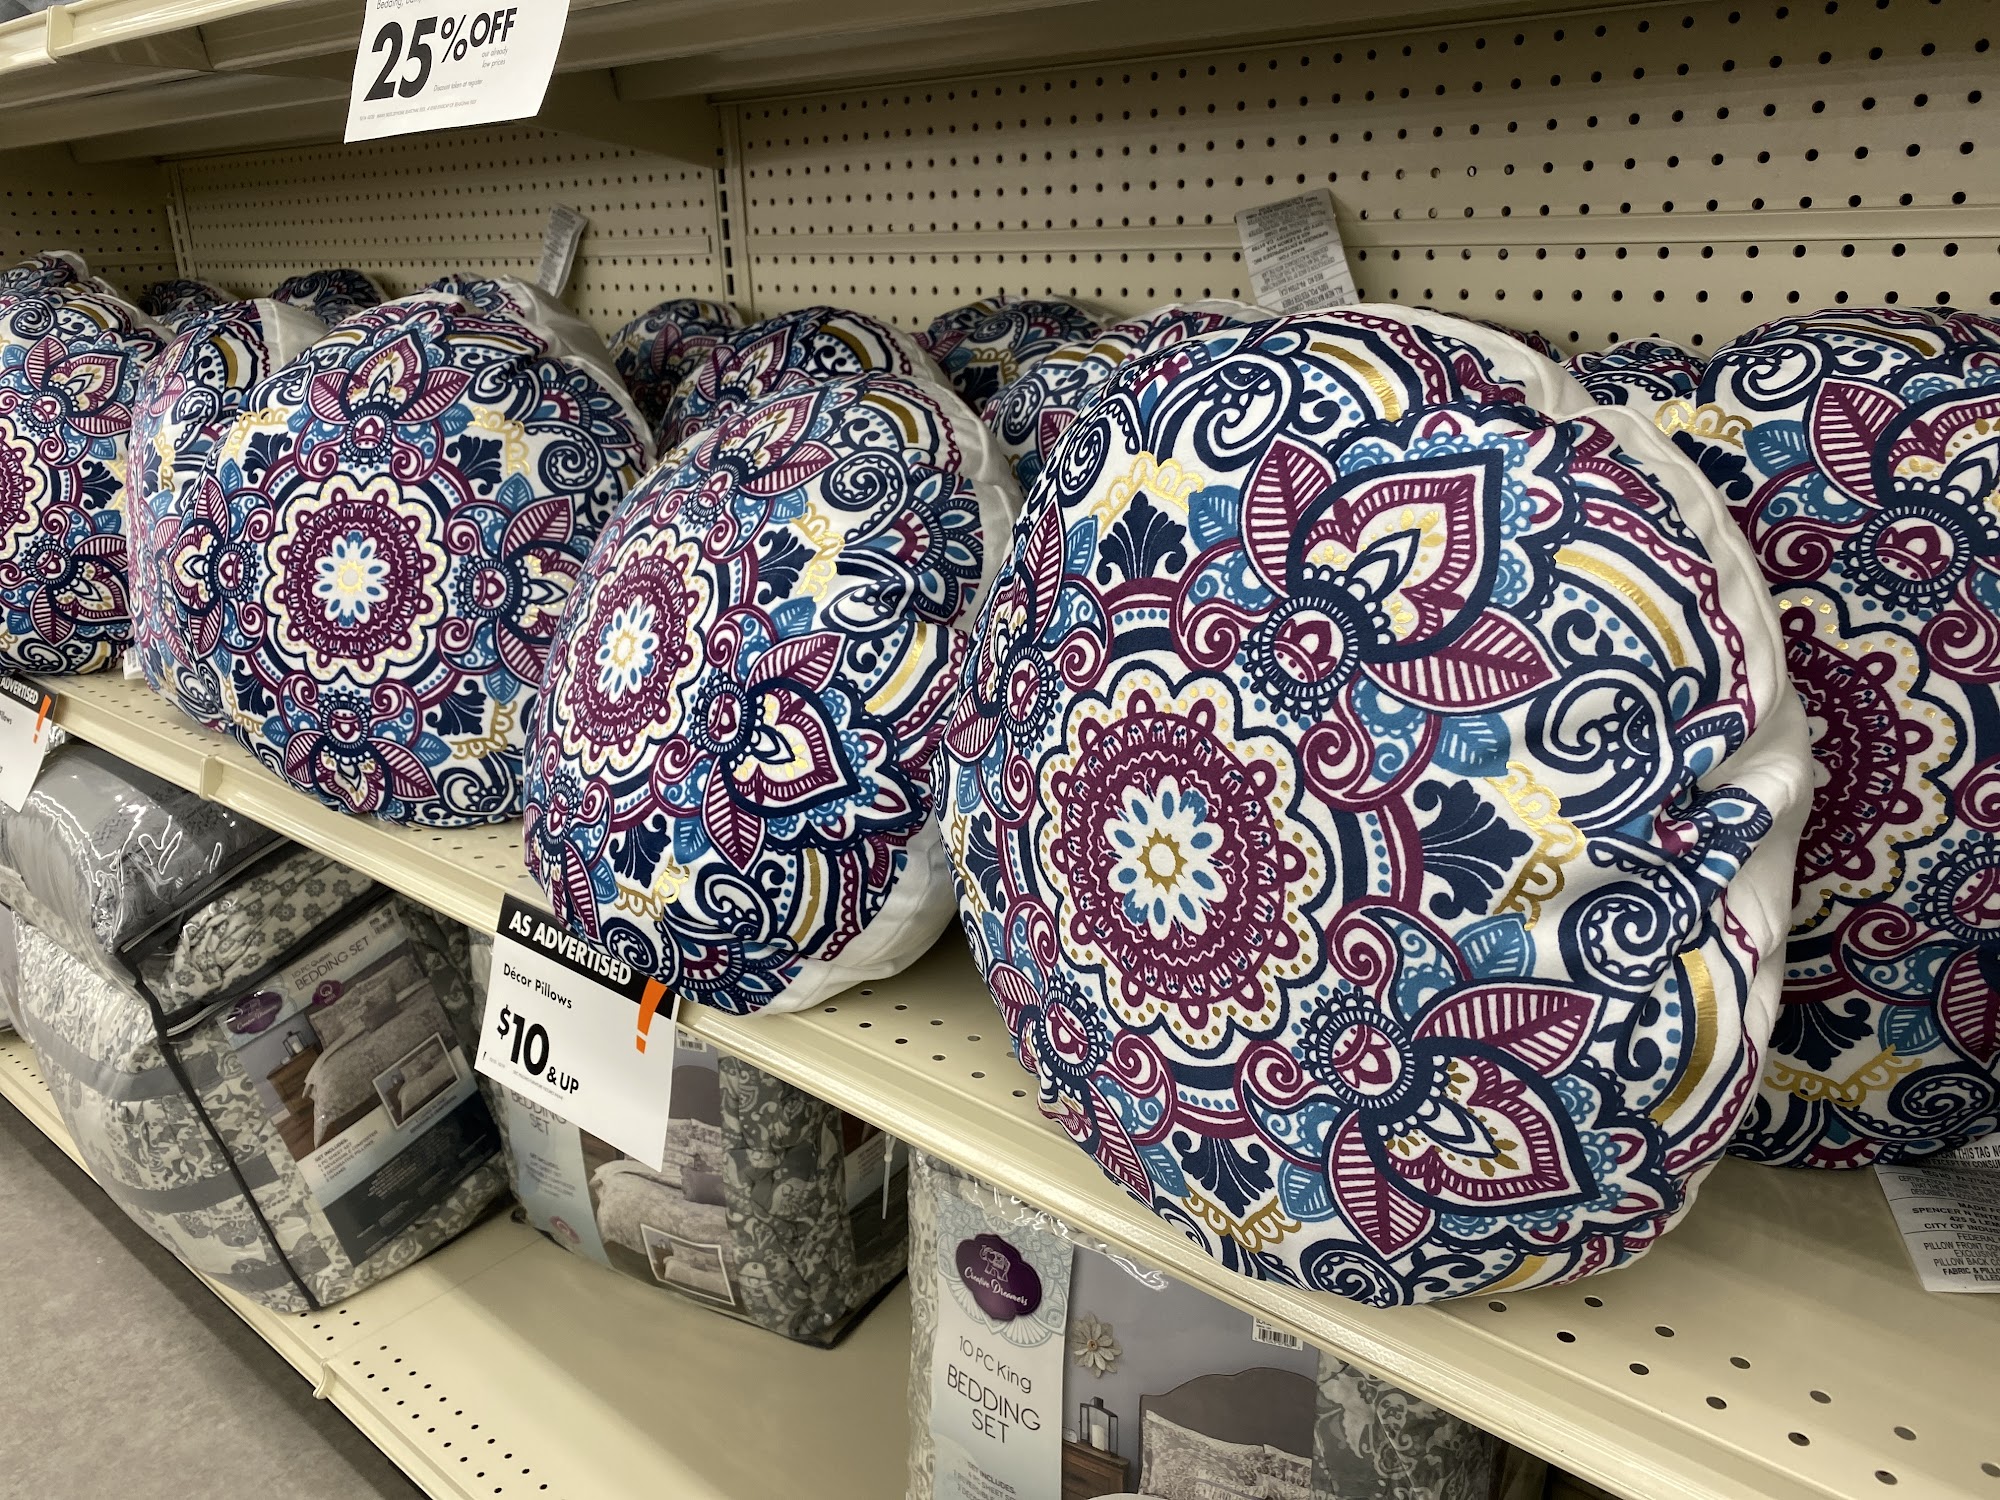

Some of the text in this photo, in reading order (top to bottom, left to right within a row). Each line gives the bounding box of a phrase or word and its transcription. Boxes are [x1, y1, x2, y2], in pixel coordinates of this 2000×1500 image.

[469, 7, 518, 48] OFF
[490, 59, 506, 68] prices
[0, 677, 39, 705] ADVERTISED
[508, 911, 632, 986] AS ADVERTISED
[295, 936, 369, 991] BEDDING SET
[503, 963, 572, 1009] Décor Pillows
[497, 1004, 550, 1076] $10
[560, 1072, 580, 1094] UP
[529, 1113, 550, 1136] SET
[1957, 1147, 1975, 1160] THIS
[1974, 1146, 1991, 1159] TAG
[1912, 1207, 1961, 1215] SPENCER
[1957, 1202, 1987, 1211] MADE
[1923, 1241, 1954, 1250] PILLOW
[1956, 1242, 1983, 1250] FRONT
[1957, 1233, 1998, 1244] FEDERAL
[1933, 1257, 1964, 1267] PILLOW
[1966, 1257, 1990, 1266] BACK
[1954, 1250, 1999, 1259] EXCLUSIVE
[1942, 1267, 1971, 1275] FABRIC
[960, 1336, 1032, 1394] 10 PC King
[947, 1363, 1041, 1431] BEDDING
[971, 1408, 1010, 1443] SET
